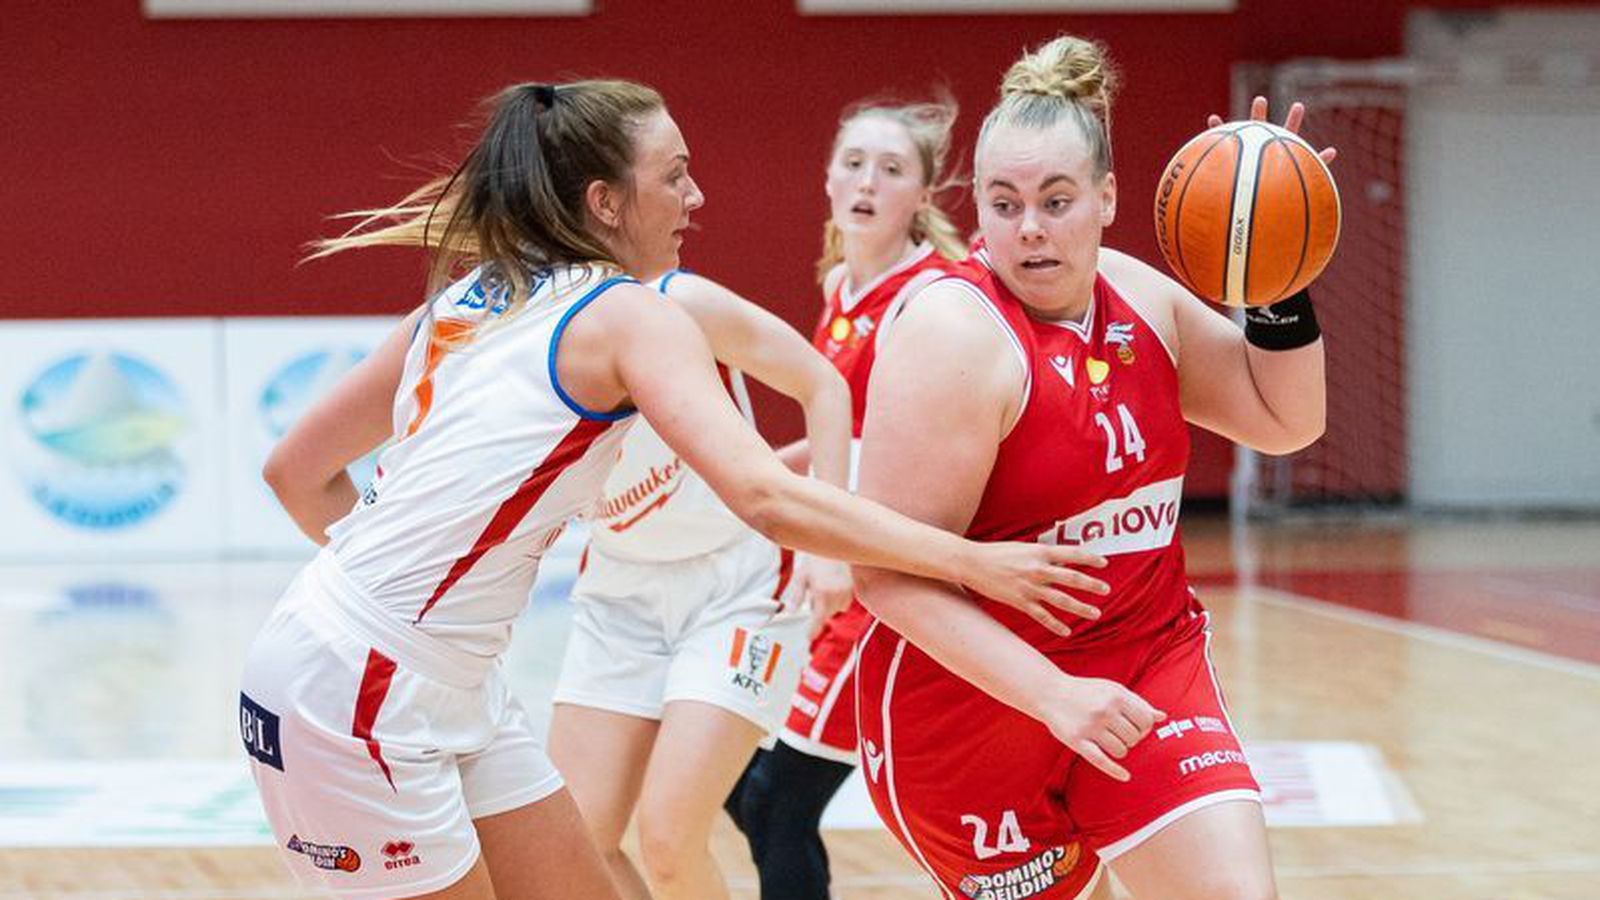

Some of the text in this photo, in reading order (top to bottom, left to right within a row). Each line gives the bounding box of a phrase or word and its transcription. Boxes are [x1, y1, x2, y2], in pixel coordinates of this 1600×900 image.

[1094, 403, 1147, 474] 24
[732, 673, 763, 695] KFC
[960, 808, 1031, 861] 24
